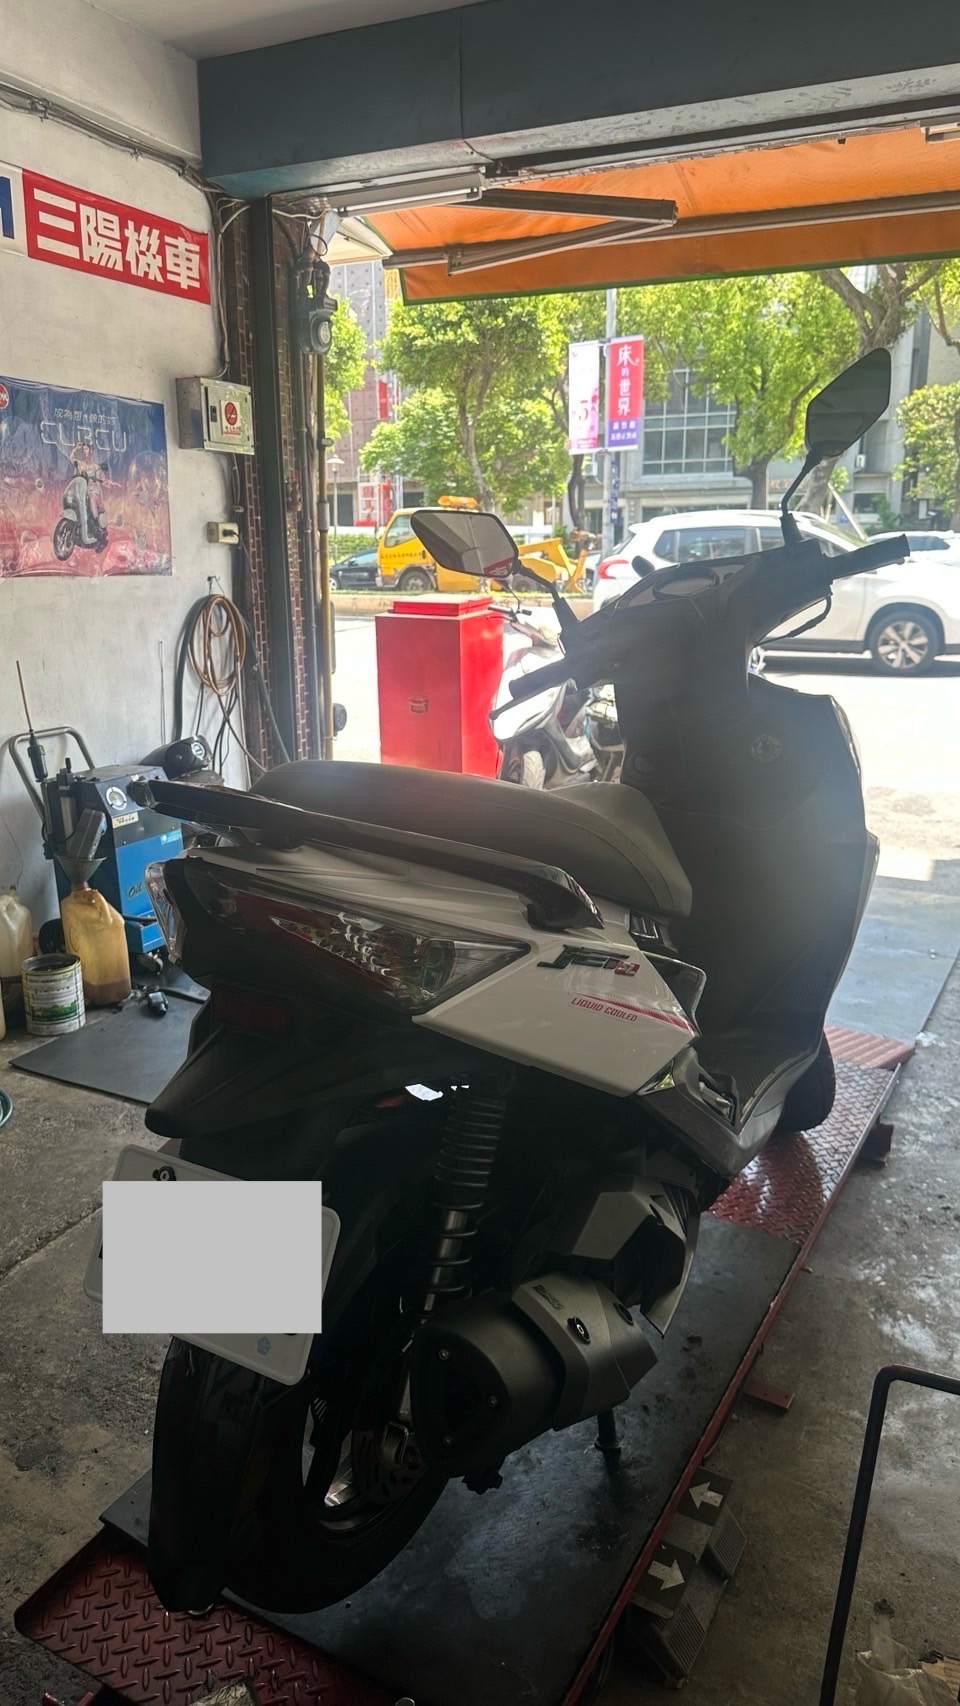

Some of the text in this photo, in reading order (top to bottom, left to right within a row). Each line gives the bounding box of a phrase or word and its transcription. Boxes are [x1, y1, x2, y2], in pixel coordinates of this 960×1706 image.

[33, 187, 201, 290] 三陽機車
[616, 344, 639, 416] 床的世界
[571, 997, 638, 1023] LIQUID COOLED
